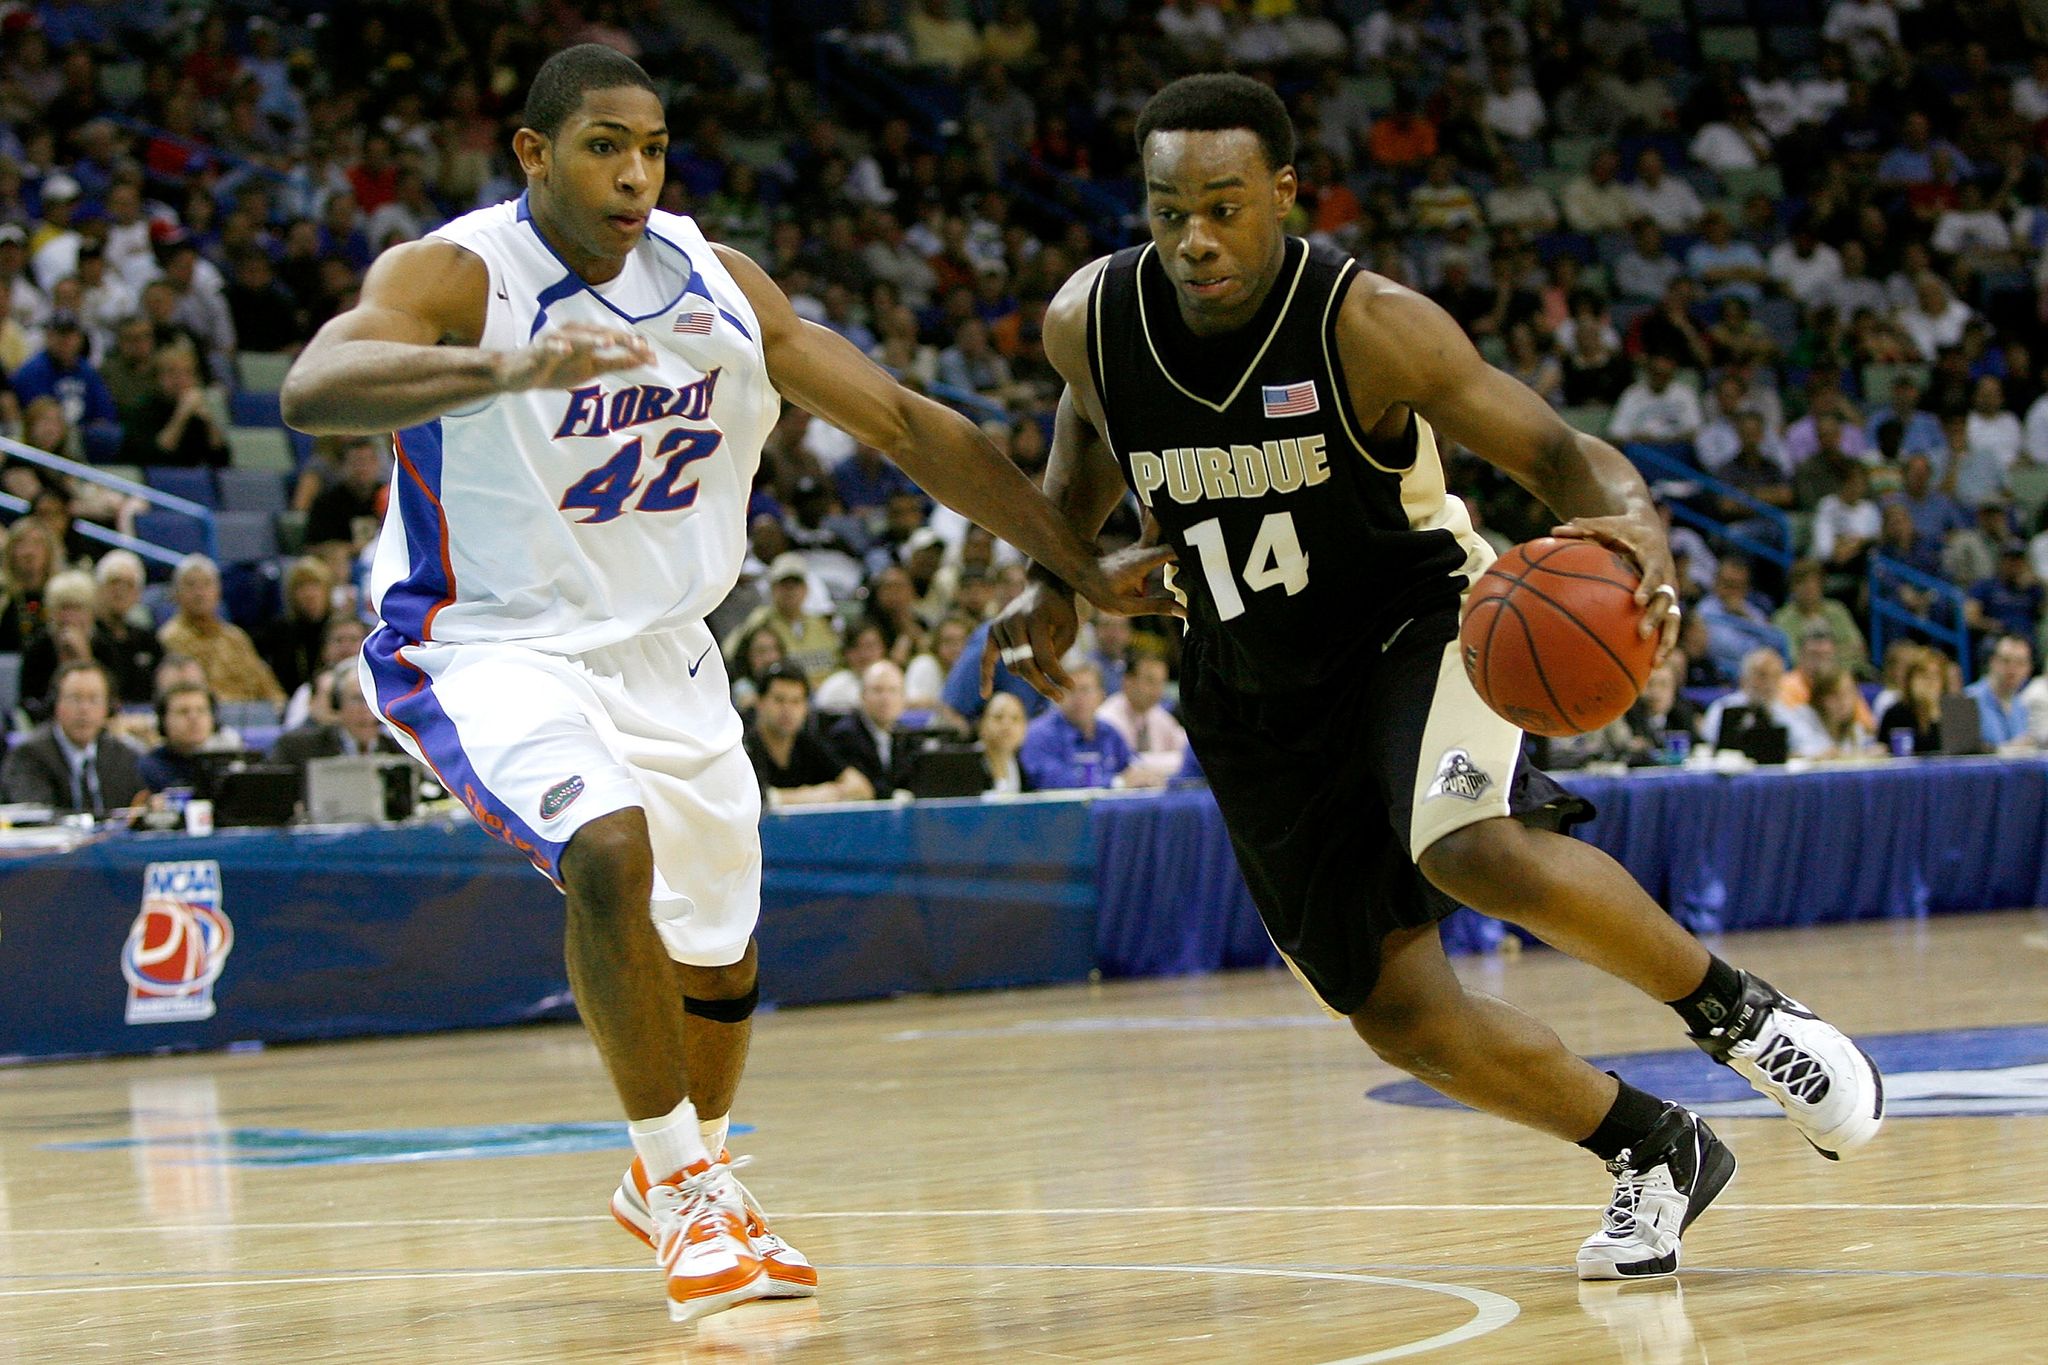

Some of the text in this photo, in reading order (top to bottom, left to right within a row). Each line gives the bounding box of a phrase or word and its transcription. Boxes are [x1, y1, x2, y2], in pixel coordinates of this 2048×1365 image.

[559, 428, 723, 523] 42
[1129, 433, 1331, 507] PURDUE
[1183, 511, 1310, 622] 14
